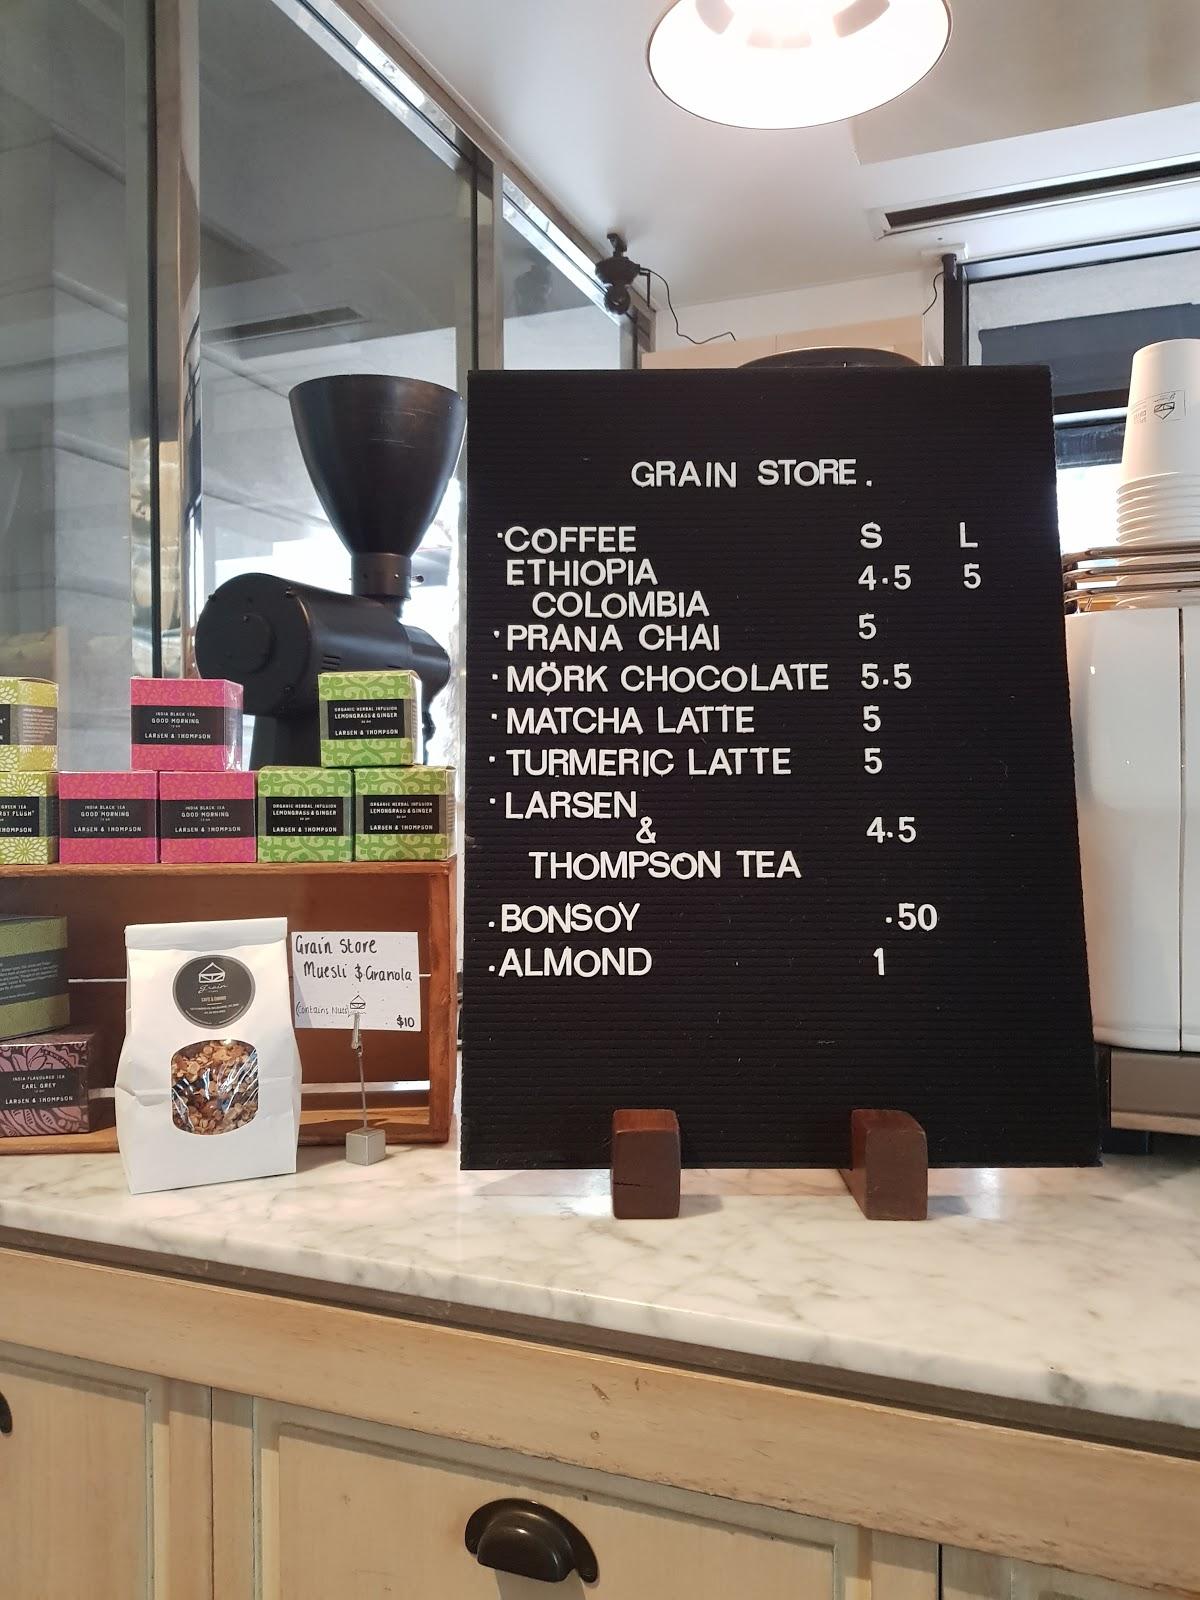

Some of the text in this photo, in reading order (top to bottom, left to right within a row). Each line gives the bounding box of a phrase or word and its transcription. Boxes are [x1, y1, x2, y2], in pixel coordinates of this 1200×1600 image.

[631, 460, 736, 488] GRAIN
[504, 521, 978, 554] COFFEE S L
[506, 558, 658, 586] ETHIOPIA
[963, 562, 982, 589] 5
[532, 590, 710, 619] COLOMBIA
[506, 612, 877, 652] PRANA CHAI 5
[507, 662, 608, 695] MÖRK
[620, 663, 828, 692] CHOCOLATE
[506, 704, 882, 735] MATCHA LATTE 5
[506, 747, 883, 777] TURMERIC LATTE 5
[505, 791, 637, 820] LARSEN
[635, 816, 656, 844] &
[528, 850, 802, 880] THOMPSON TEA
[501, 902, 640, 933] BONSOY
[295, 934, 378, 955] Grain Store
[303, 960, 348, 979] Muesli
[365, 965, 413, 982] Granola
[498, 946, 885, 978] ALMOND 1
[396, 1014, 416, 1029] $10
[39, 1095, 73, 1103] THOMPSON
